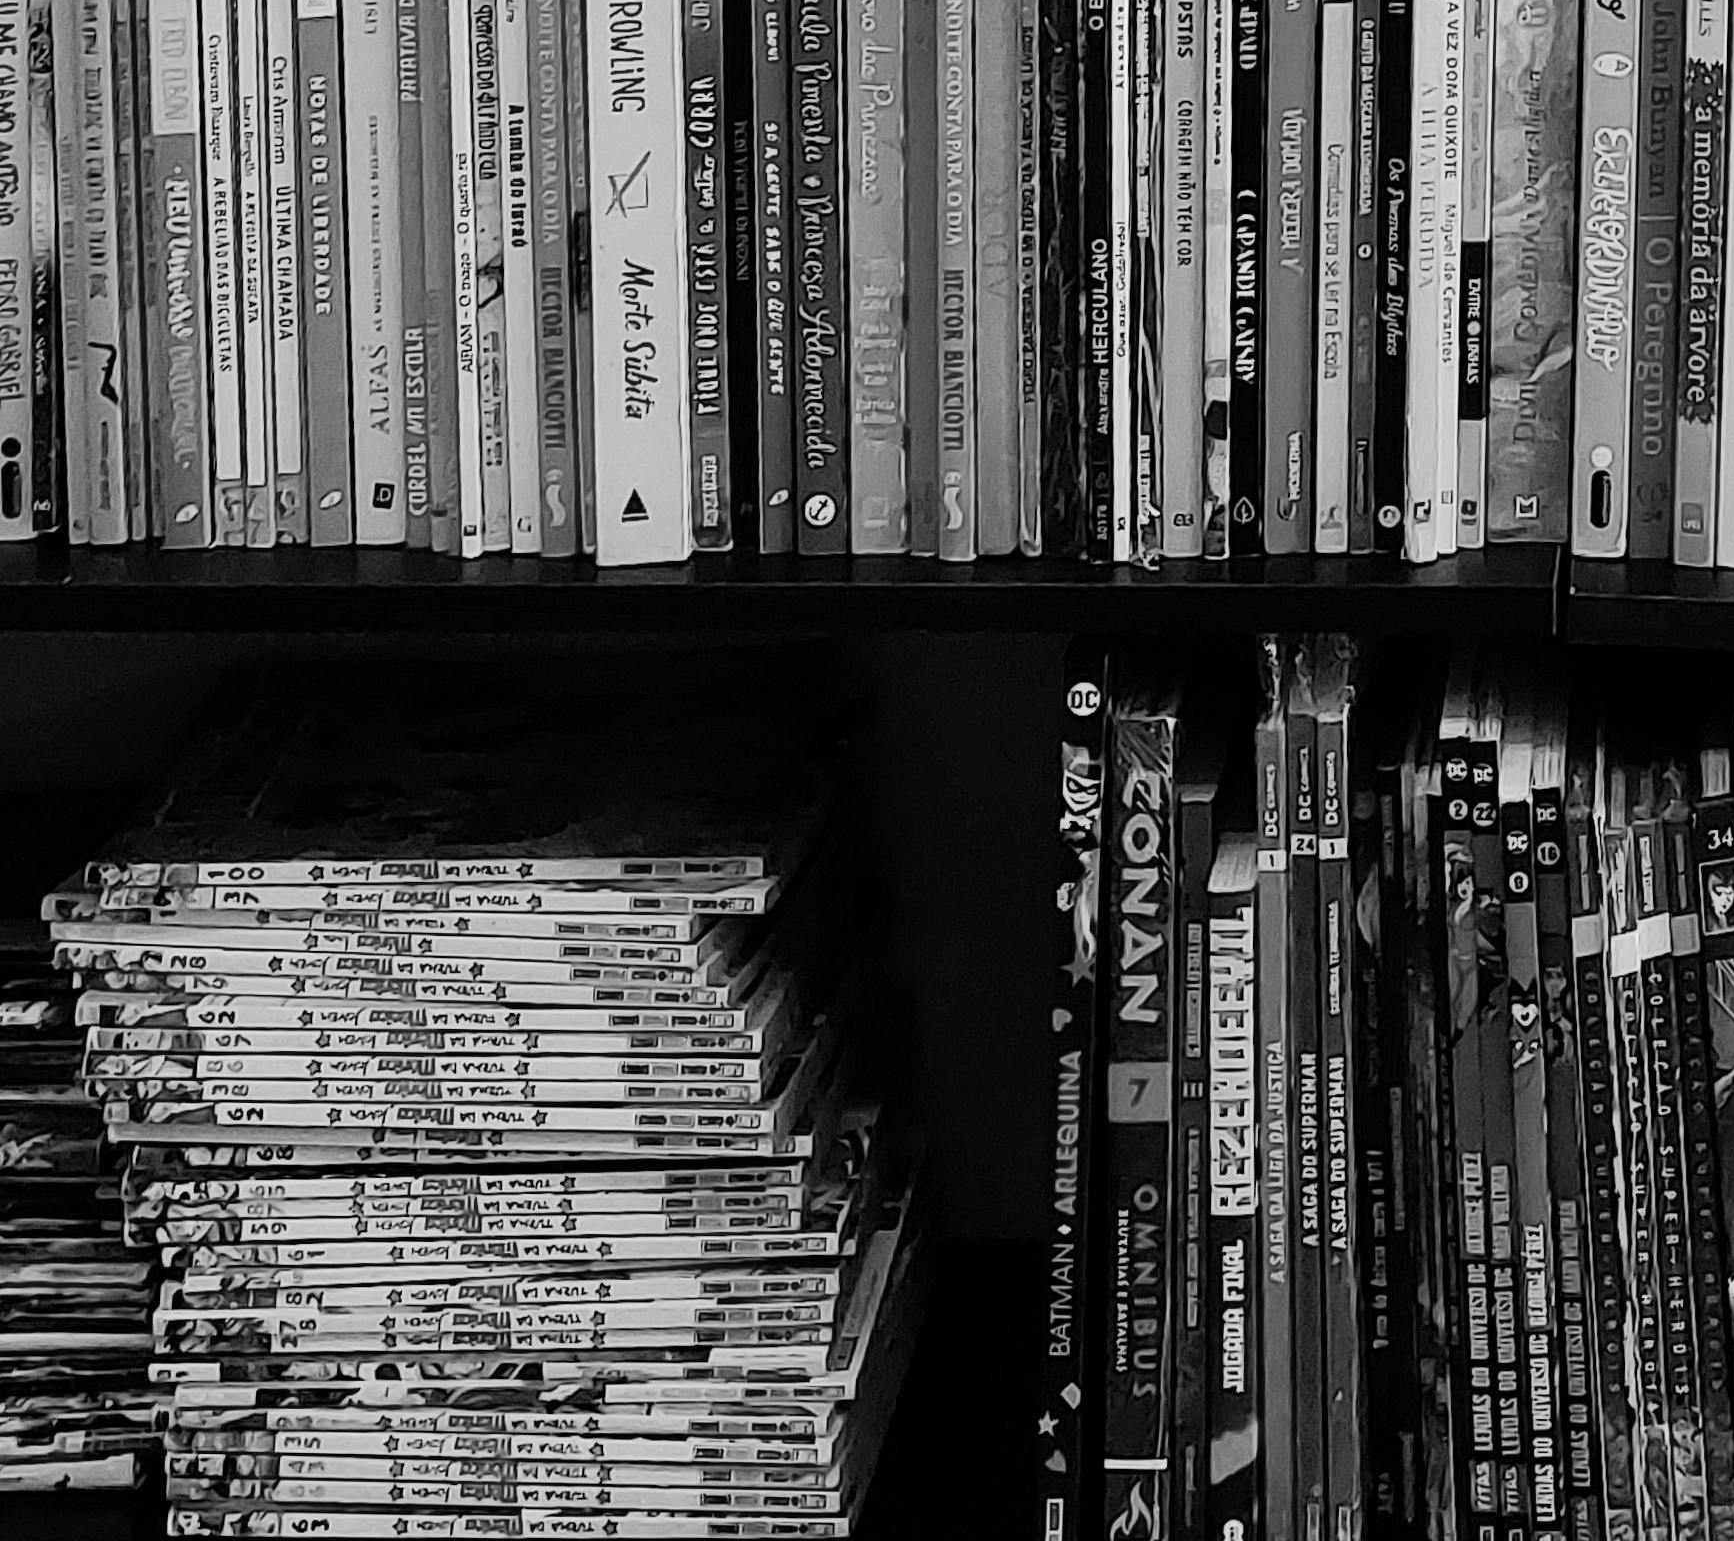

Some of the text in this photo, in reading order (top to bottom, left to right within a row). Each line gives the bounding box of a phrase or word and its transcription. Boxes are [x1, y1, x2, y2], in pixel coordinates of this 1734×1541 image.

[308, 75, 329, 147] NOTAS
[309, 155, 330, 185] DE
[1692, 132, 1724, 256] memória
[619, 259, 654, 330] Morte
[1689, 267, 1715, 299] da
[1686, 309, 1716, 403] árvore
[1049, 1051, 1081, 1355] BATMAN ARLEQUINA
[1130, 1184, 1161, 1399] OMNIBUS
